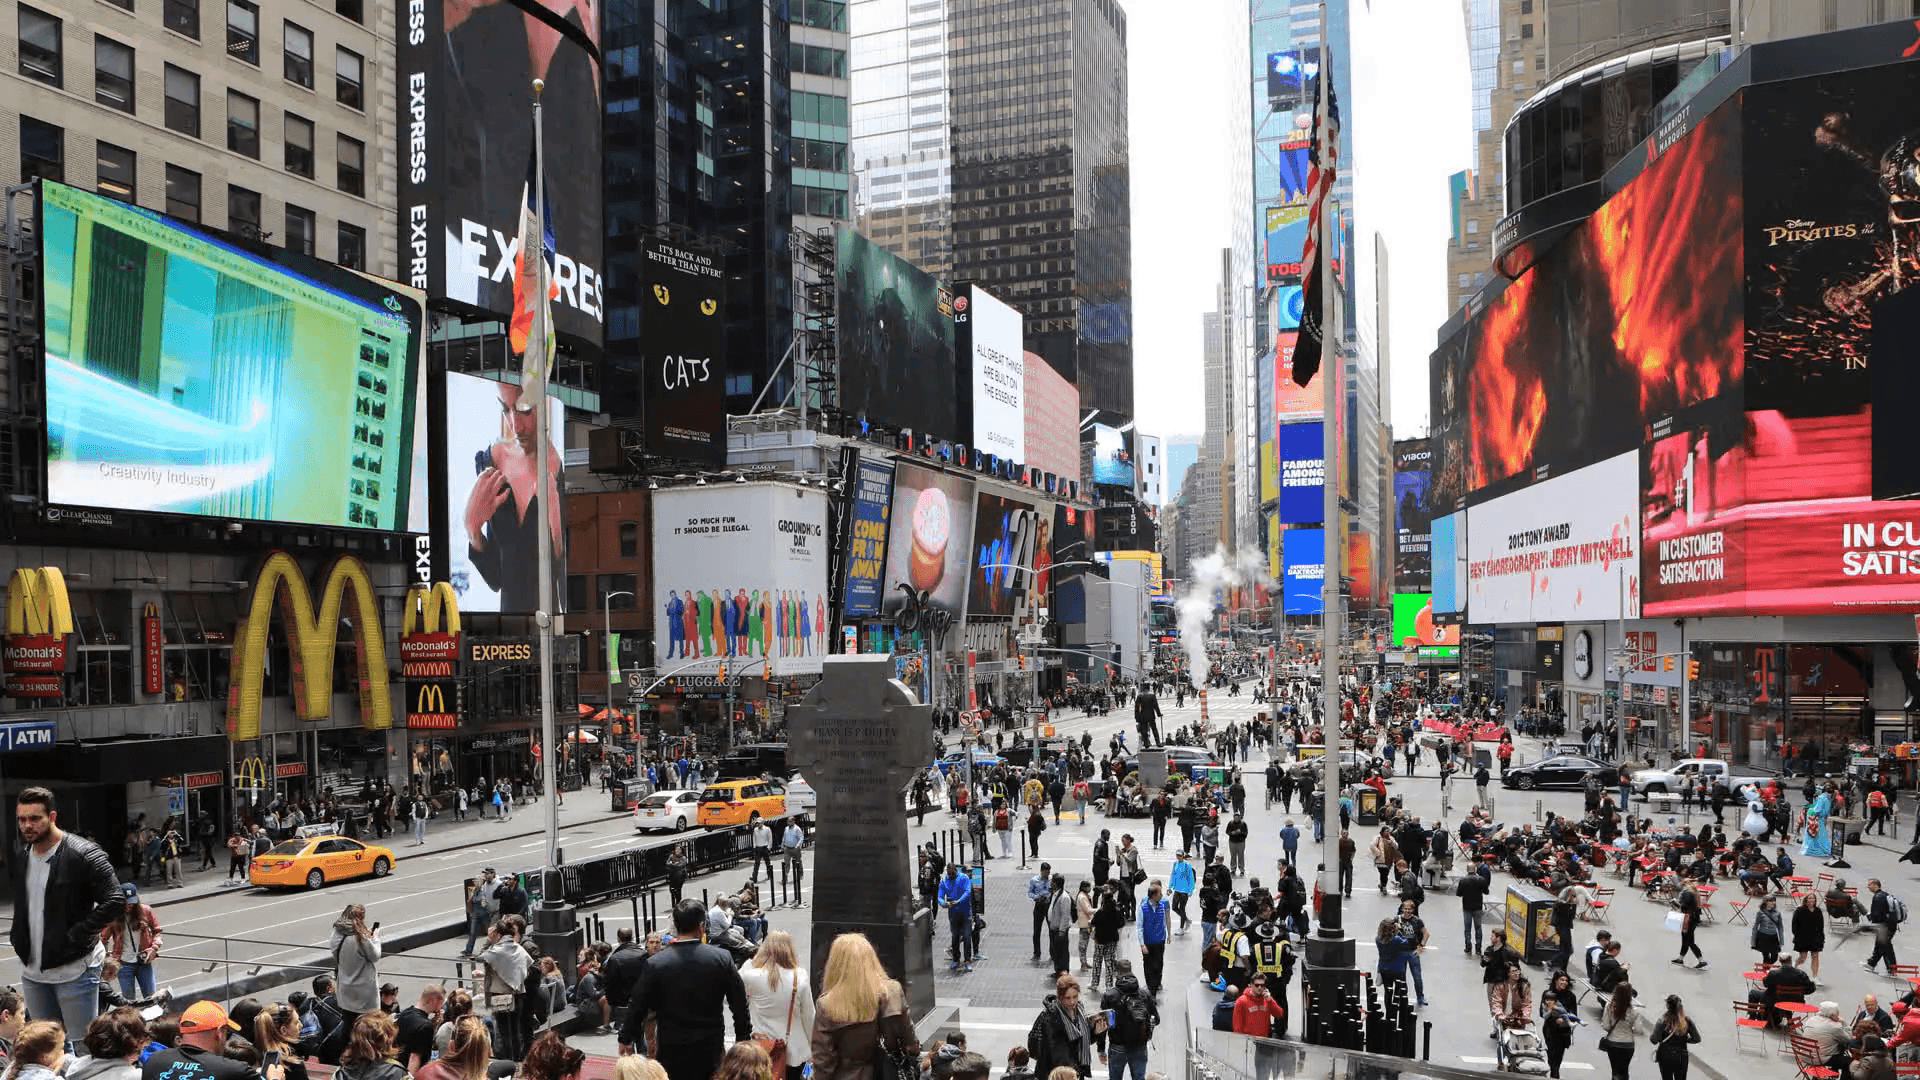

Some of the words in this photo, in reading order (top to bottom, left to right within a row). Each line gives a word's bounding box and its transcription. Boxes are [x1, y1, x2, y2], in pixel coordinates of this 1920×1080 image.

[409, 72, 427, 184] EXPRESS
[1659, 105, 1690, 138] MARRIOTT
[1280, 140, 1312, 150] TOSHI
[1659, 123, 1687, 153] MARQUIS
[1785, 219, 1815, 229] Disney
[1762, 223, 1857, 247] PIRATES
[410, 204, 427, 290] EXPRE
[659, 244, 674, 256] IT'S
[675, 248, 694, 261] BACK
[696, 256, 712, 266] AND
[678, 259, 699, 272] THAN
[954, 313, 967, 323] LG
[1844, 356, 1867, 370] IN
[663, 355, 710, 390] CATS
[99, 462, 162, 485] Creativity
[167, 469, 216, 490] Industry
[1283, 469, 1325, 478] AMONG
[1283, 477, 1324, 487] FRIEND
[1674, 452, 1694, 526] #1
[688, 518, 698, 526] SO
[700, 517, 720, 525] MUCH
[722, 516, 736, 524] FUN
[854, 519, 886, 539] COME
[674, 527, 681, 535] IT
[684, 526, 709, 534] SHOULD
[711, 525, 720, 533] BE
[1508, 532, 1524, 550] 2013
[1525, 529, 1543, 547] TONY
[1543, 522, 1570, 542] AWARD
[1842, 522, 1875, 548] IN
[793, 535, 806, 548] DAY
[1400, 543, 1429, 553] WEEKEND
[1660, 540, 1669, 562] IN
[1670, 531, 1724, 560] CUSTOMER
[1470, 560, 1486, 579] BEST
[1550, 544, 1578, 569] JERRY
[1580, 536, 1633, 565] MITCHELL
[850, 560, 882, 580] AWAY
[1660, 557, 1724, 585] SATISFACTION
[4, 647, 62, 659] McDonald's
[402, 640, 456, 651] McDonald's
[472, 643, 531, 661] EXPRESS
[13, 660, 53, 668] Restaurant
[35, 683, 59, 692] HOURS
[641, 675, 667, 687] FTS
[15, 729, 51, 745] ATM
